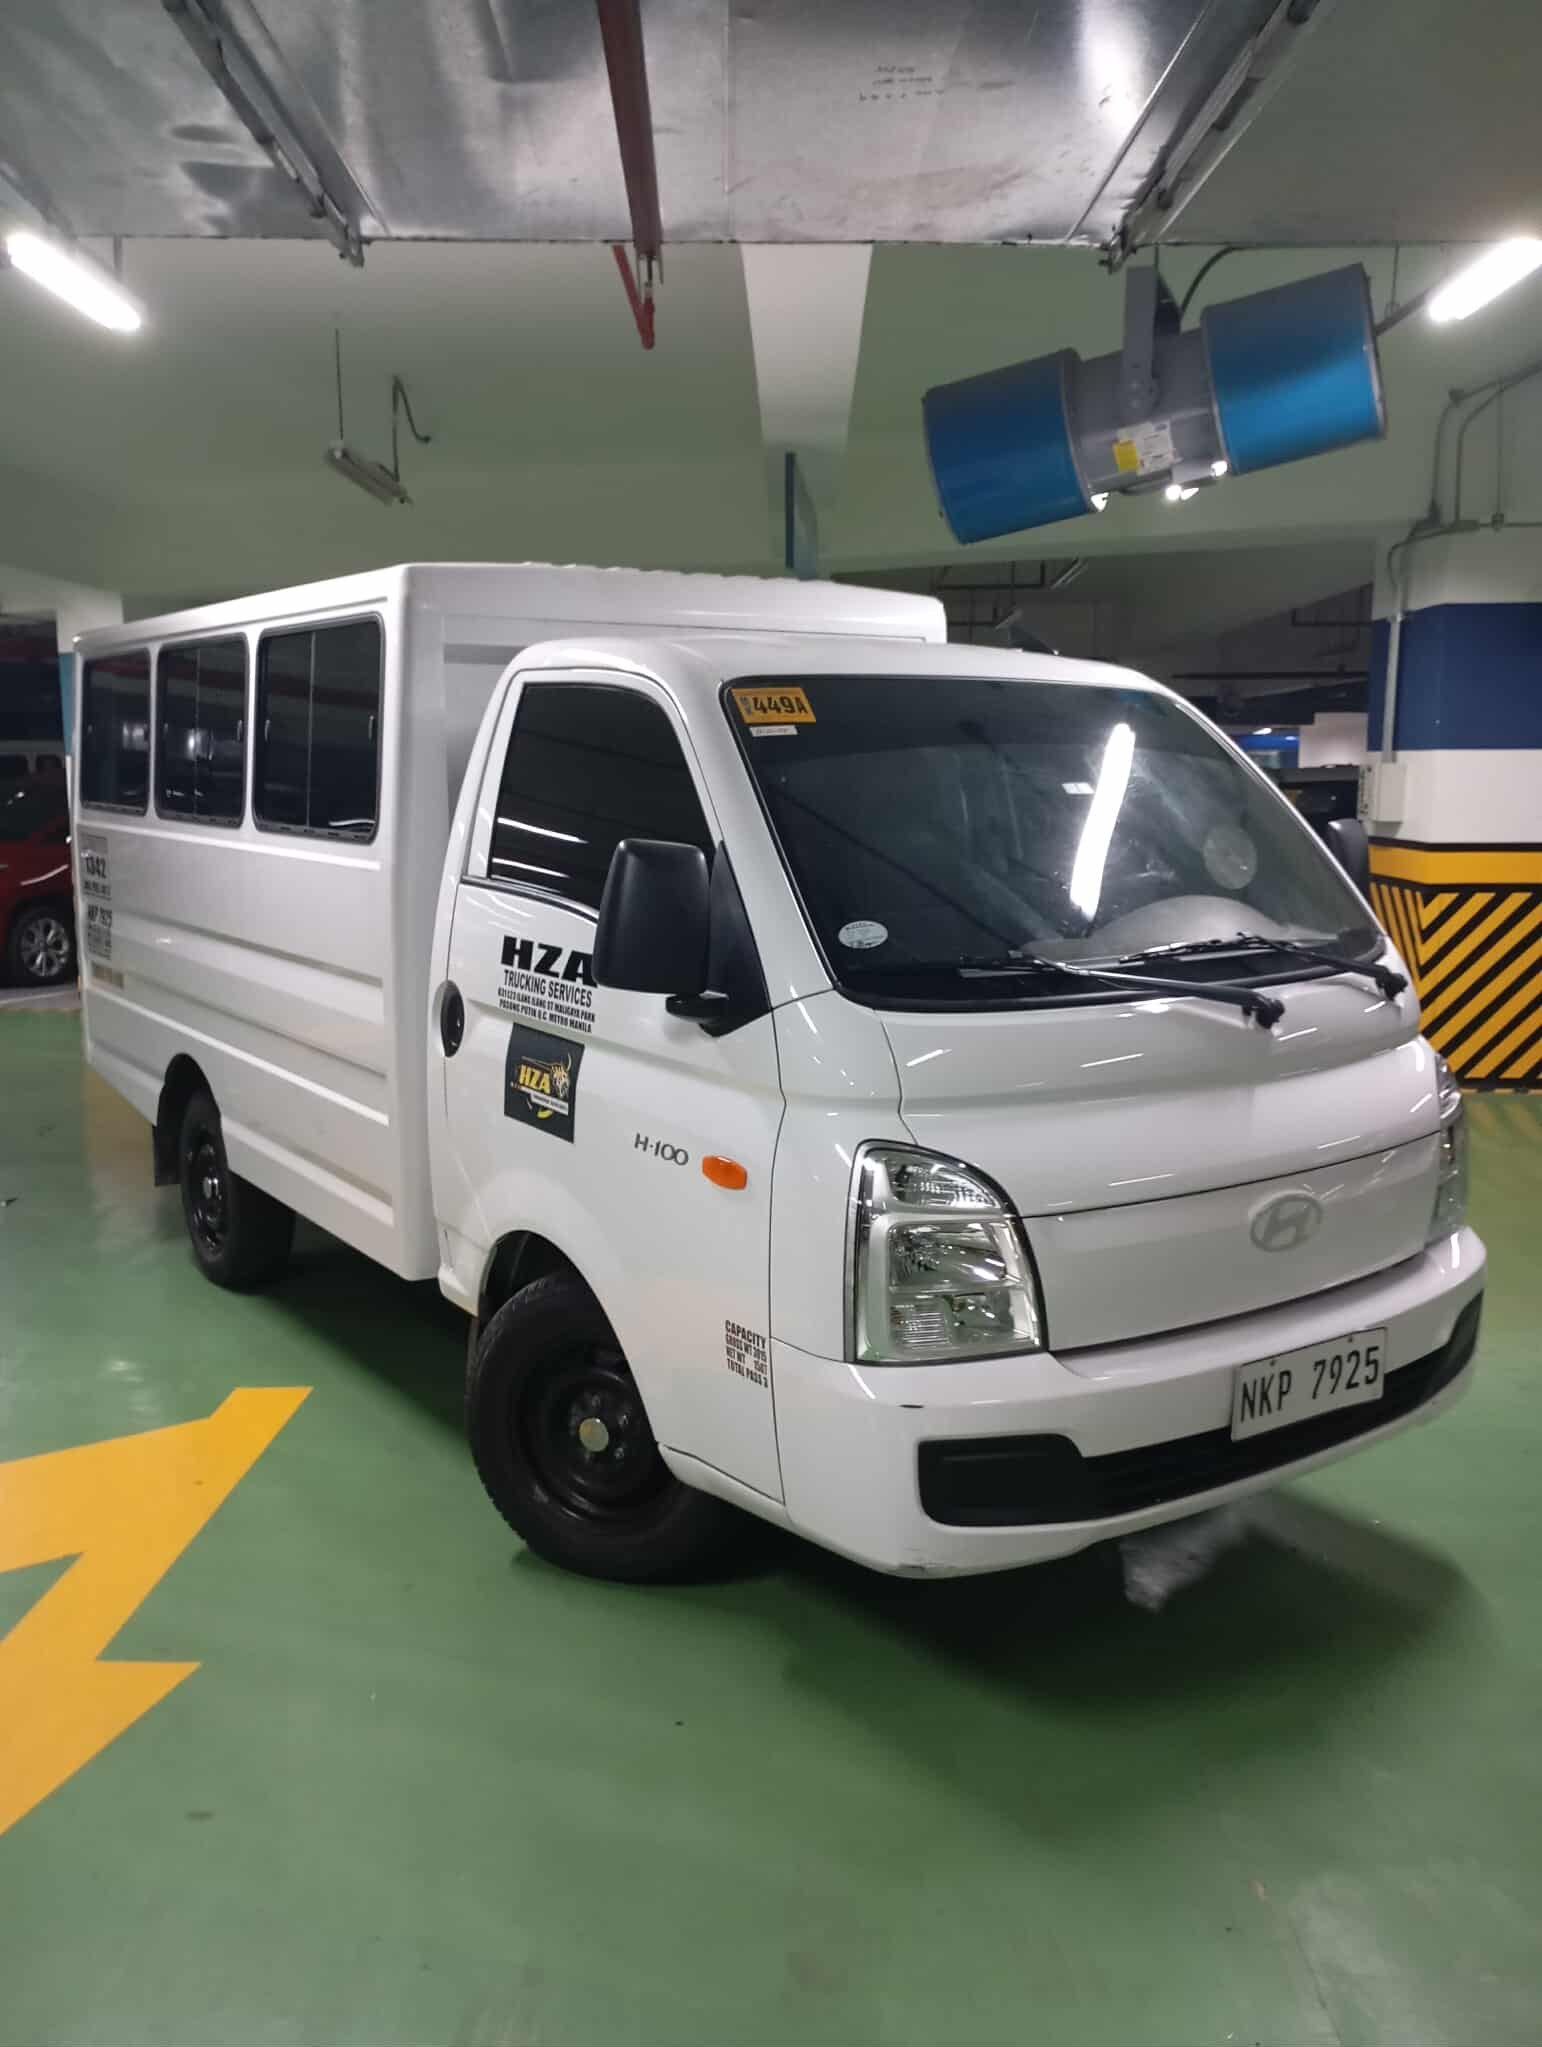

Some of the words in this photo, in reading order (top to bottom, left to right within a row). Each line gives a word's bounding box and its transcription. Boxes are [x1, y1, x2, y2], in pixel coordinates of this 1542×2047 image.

[752, 696, 808, 714] 449A
[501, 935, 598, 988] HZA
[504, 969, 546, 995] TRUCKING
[548, 981, 592, 1008] SERVICES
[549, 1013, 569, 1026] METRO
[570, 1019, 592, 1032] MANILA
[519, 1064, 551, 1095] HZA
[725, 1320, 766, 1349] CAPACITY
[727, 1358, 744, 1376] TOTAL
[746, 1368, 762, 1386] PASS
[1241, 1370, 1292, 1422] NKP
[1312, 1346, 1379, 1400] 7925
